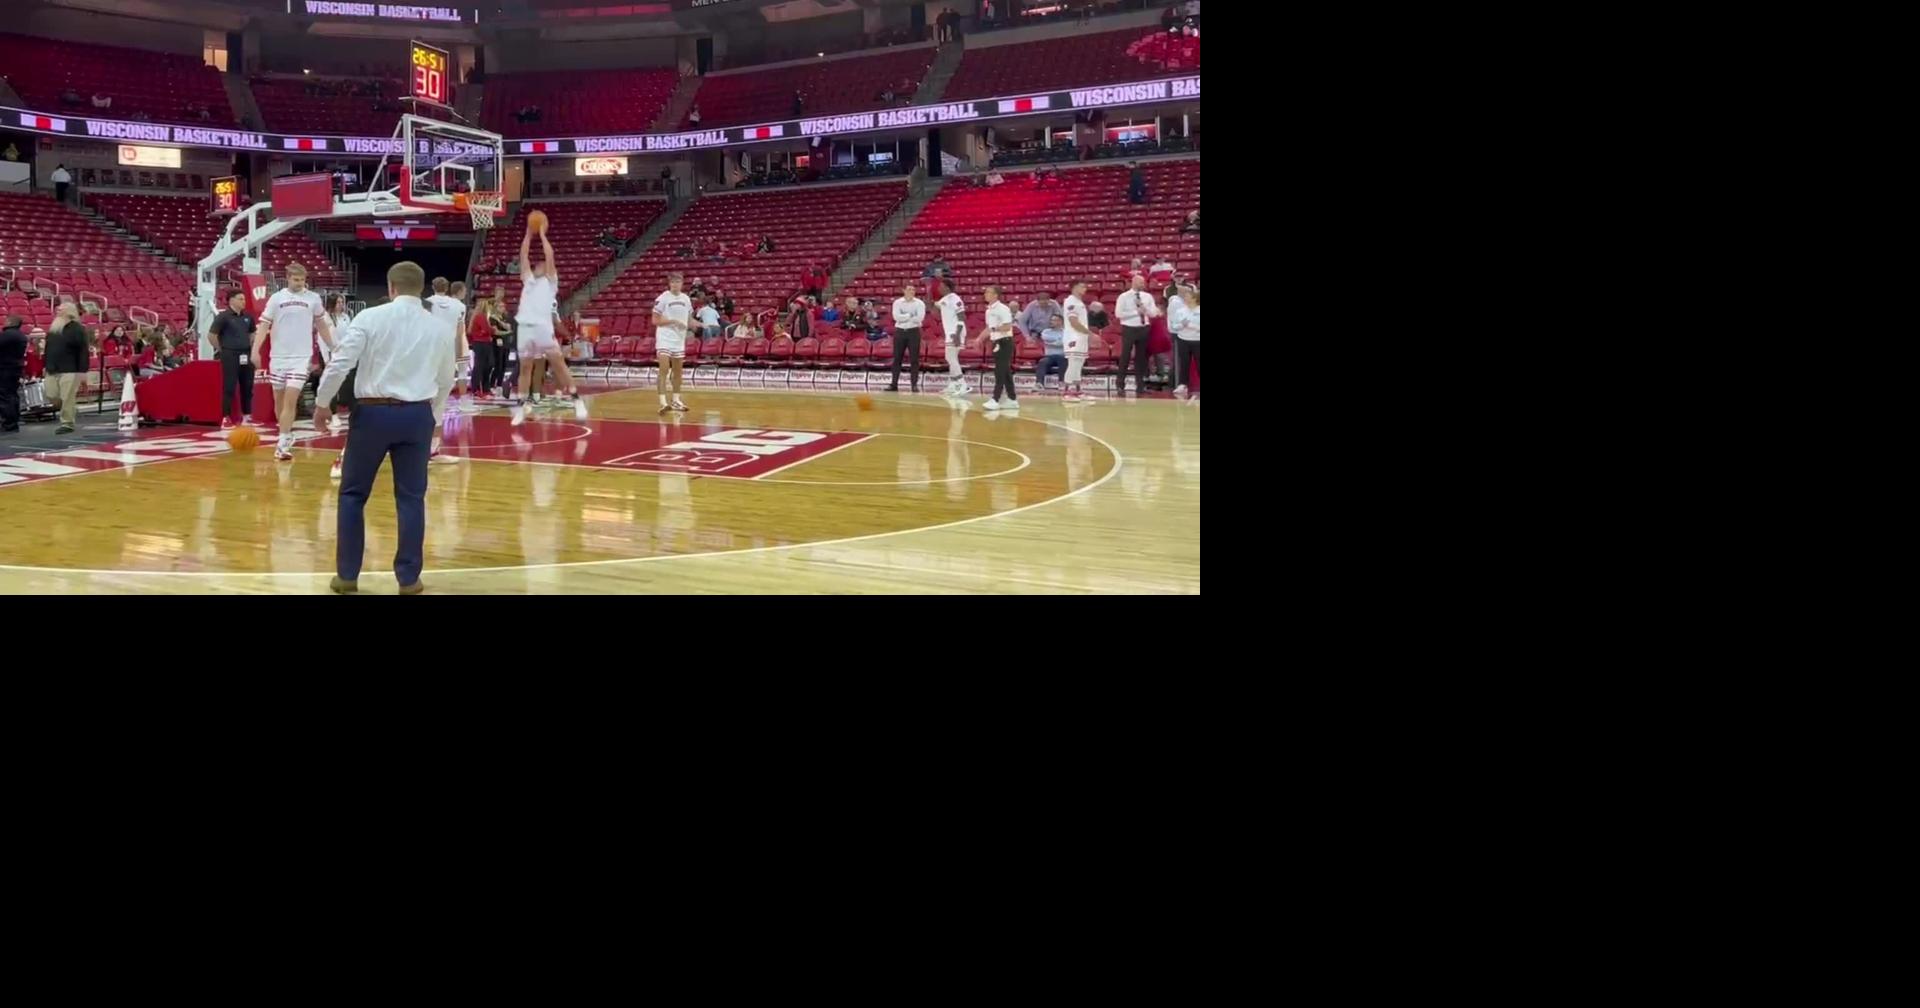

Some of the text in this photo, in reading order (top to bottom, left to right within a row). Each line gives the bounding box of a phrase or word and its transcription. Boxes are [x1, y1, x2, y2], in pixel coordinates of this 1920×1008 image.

[305, 0, 461, 21] WISCONSIN BASKETBALL
[412, 47, 444, 71] 26:51
[415, 65, 439, 98] 30
[1069, 82, 1166, 107] WISCONSIN
[800, 104, 979, 135] WISCONSIN BASKETBALL
[86, 120, 267, 149] WISCONSIN BASKETBALL
[574, 131, 728, 152] WISCONSIN BASKETBALL
[219, 193, 233, 208] 30
